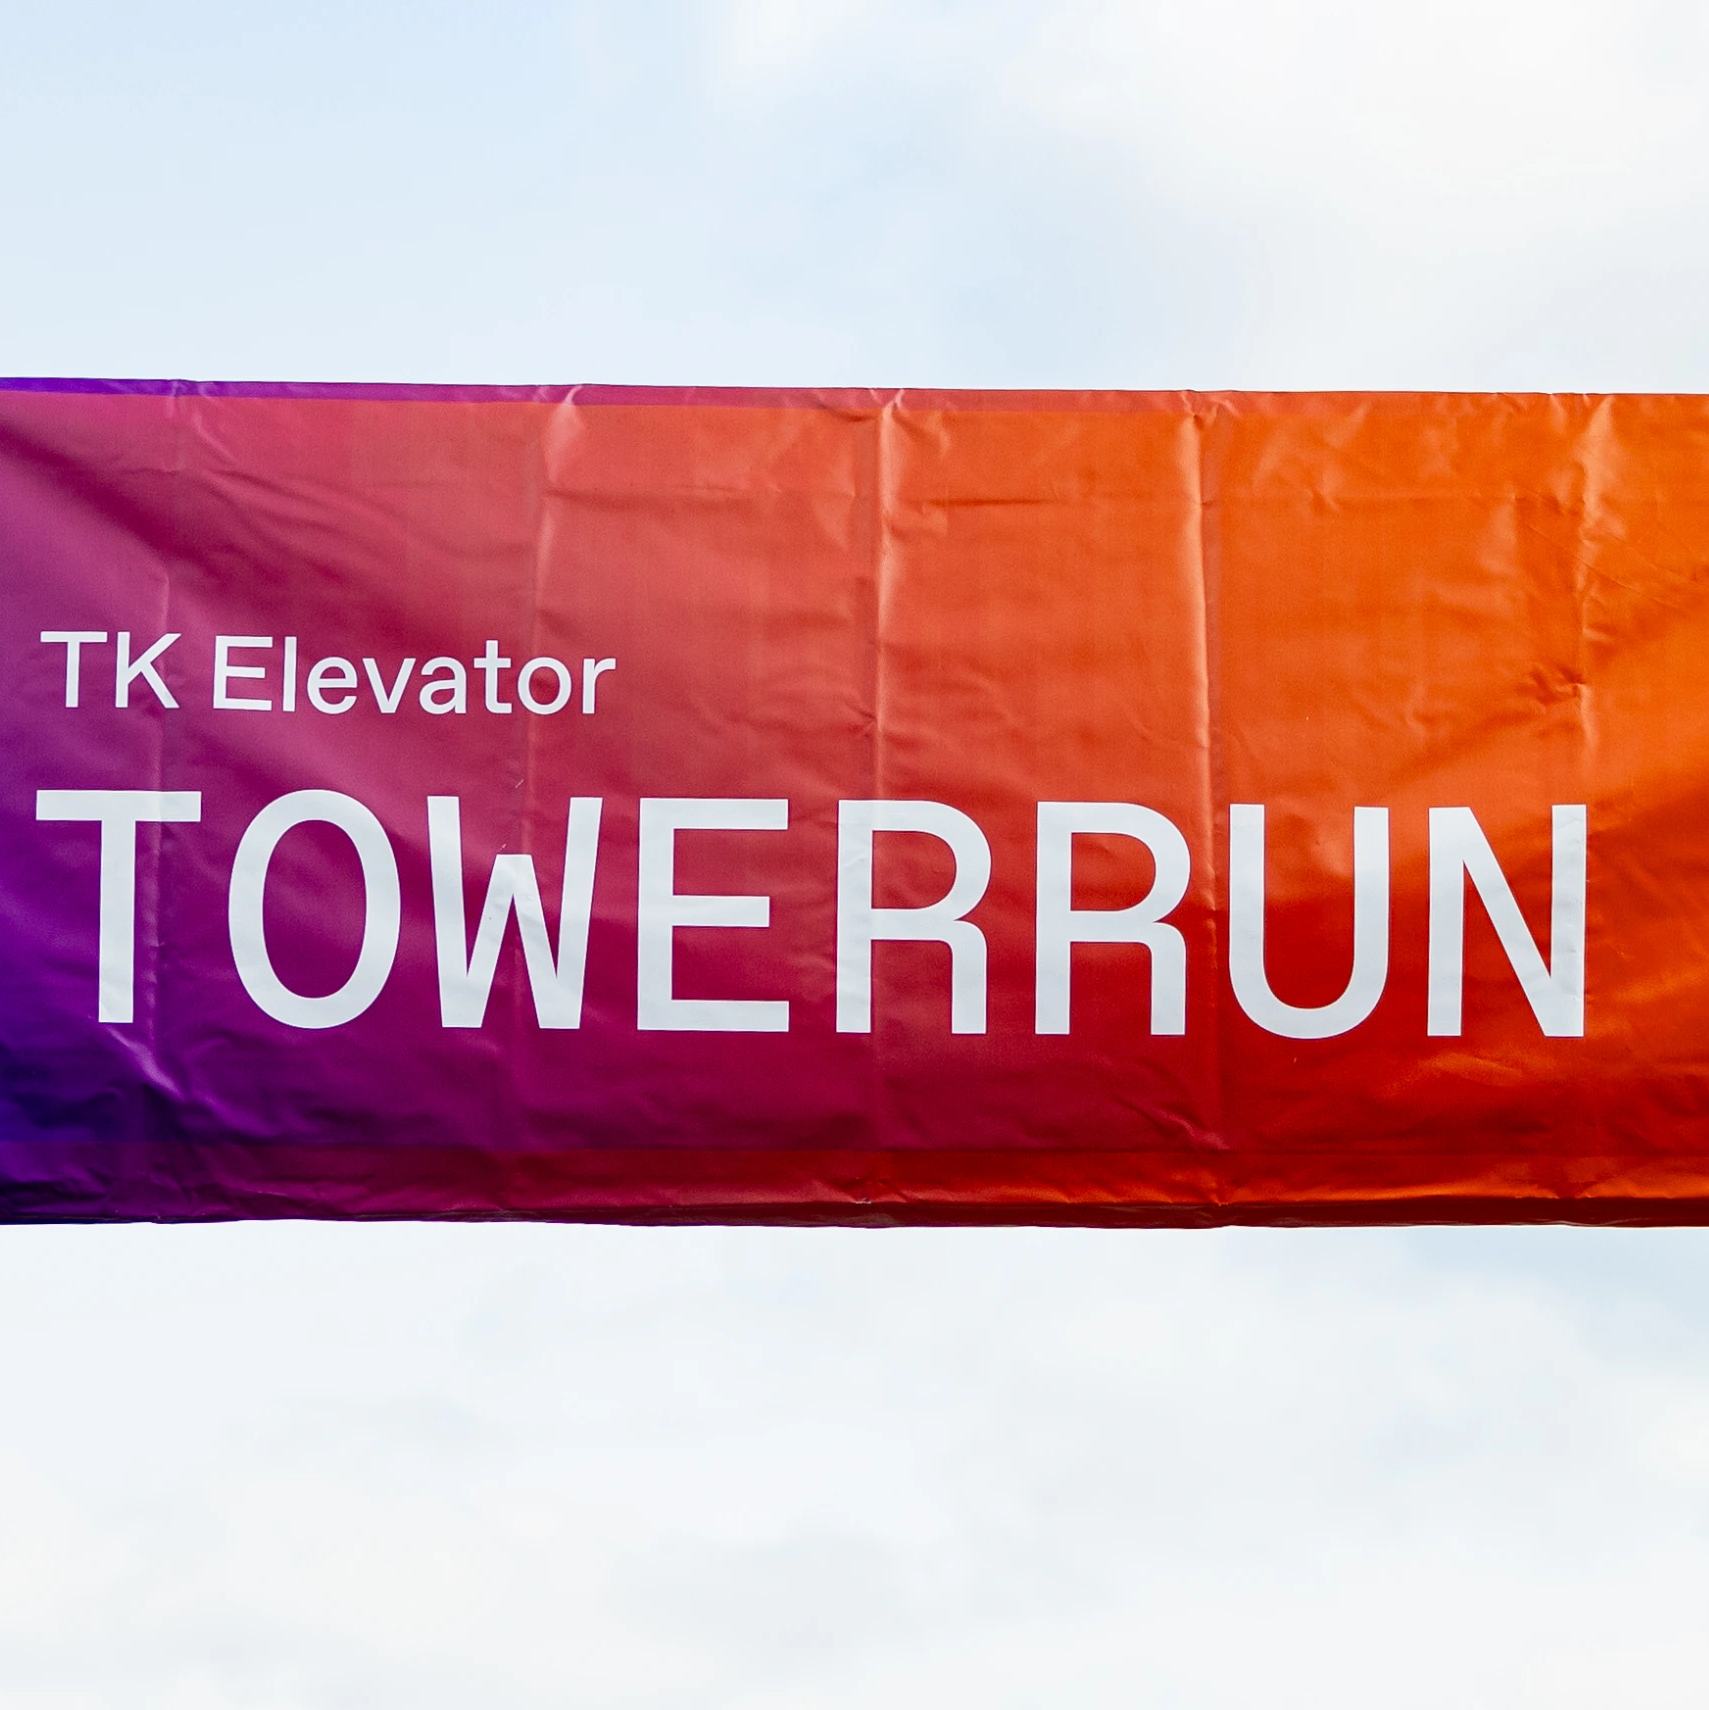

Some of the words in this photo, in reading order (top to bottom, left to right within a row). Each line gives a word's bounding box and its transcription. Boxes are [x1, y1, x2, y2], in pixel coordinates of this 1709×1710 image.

[40, 631, 181, 710] TK
[213, 635, 616, 716] Elevator
[35, 787, 1587, 1041] TOWERRUN
